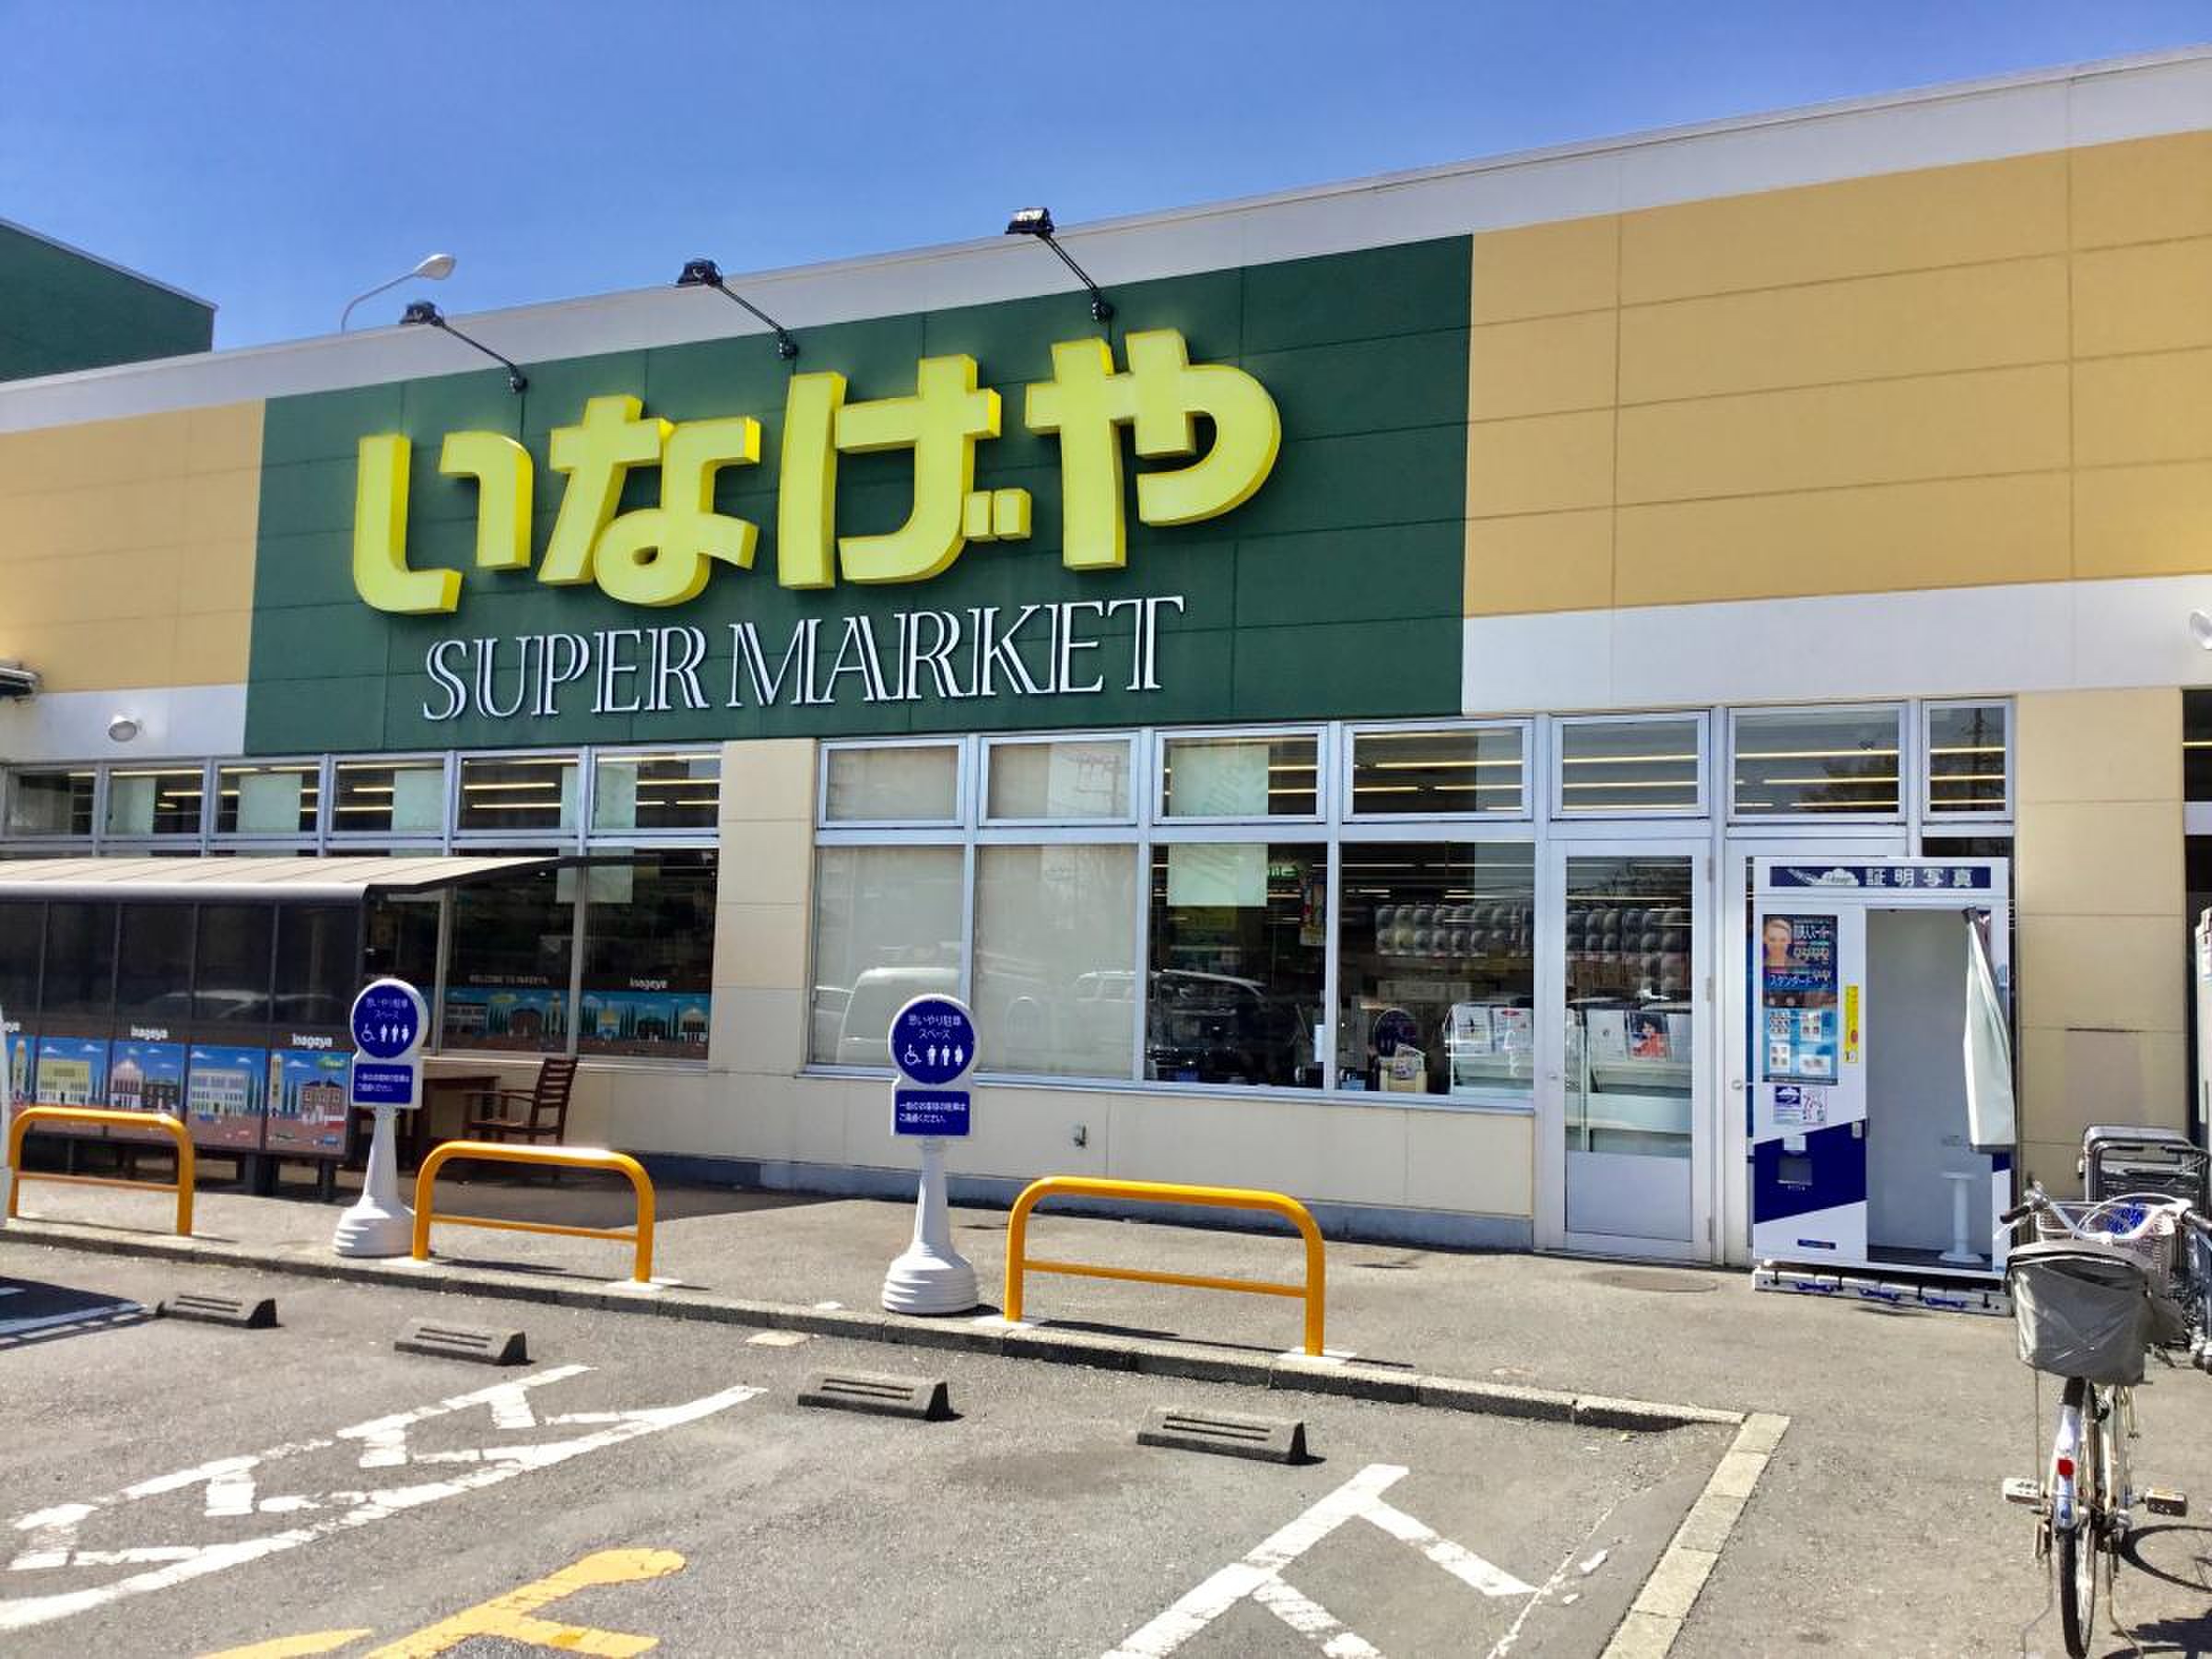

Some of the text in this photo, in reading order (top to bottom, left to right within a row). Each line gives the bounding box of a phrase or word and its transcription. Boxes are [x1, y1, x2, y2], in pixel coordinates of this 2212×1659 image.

[352, 329, 1282, 615] いなげや
[423, 594, 1185, 723] SUPER MARKET
[1865, 868, 1973, 887] 証明写真
